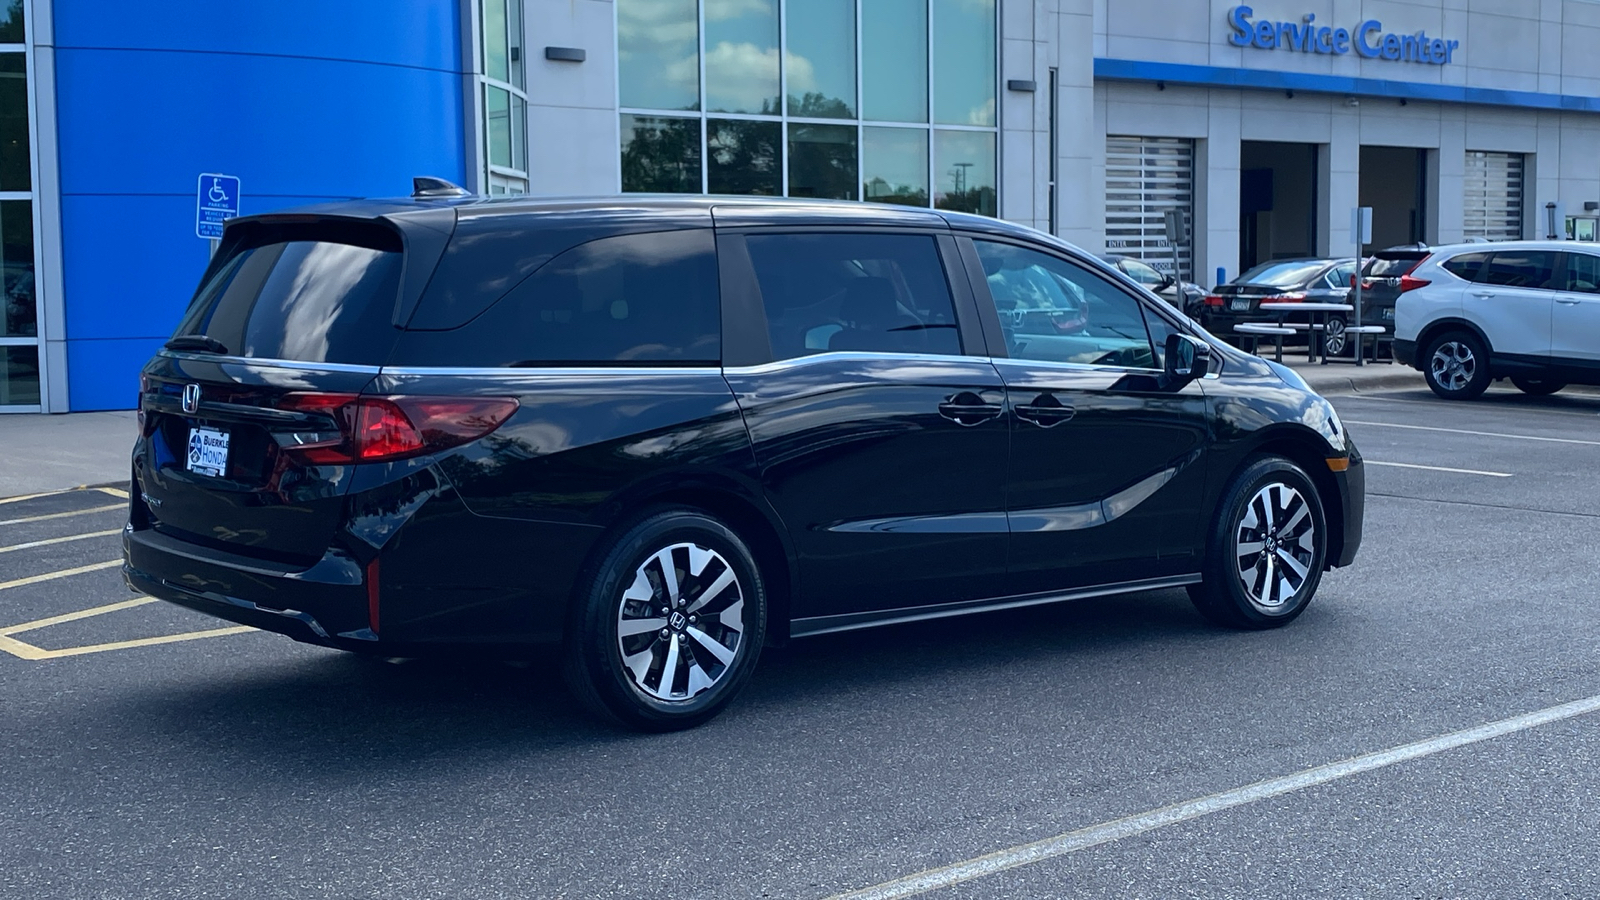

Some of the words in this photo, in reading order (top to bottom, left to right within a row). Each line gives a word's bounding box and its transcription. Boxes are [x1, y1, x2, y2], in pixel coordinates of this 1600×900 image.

[1228, 5, 1349, 54] Service
[1354, 19, 1459, 65] Center
[203, 446, 227, 466] HONDA
